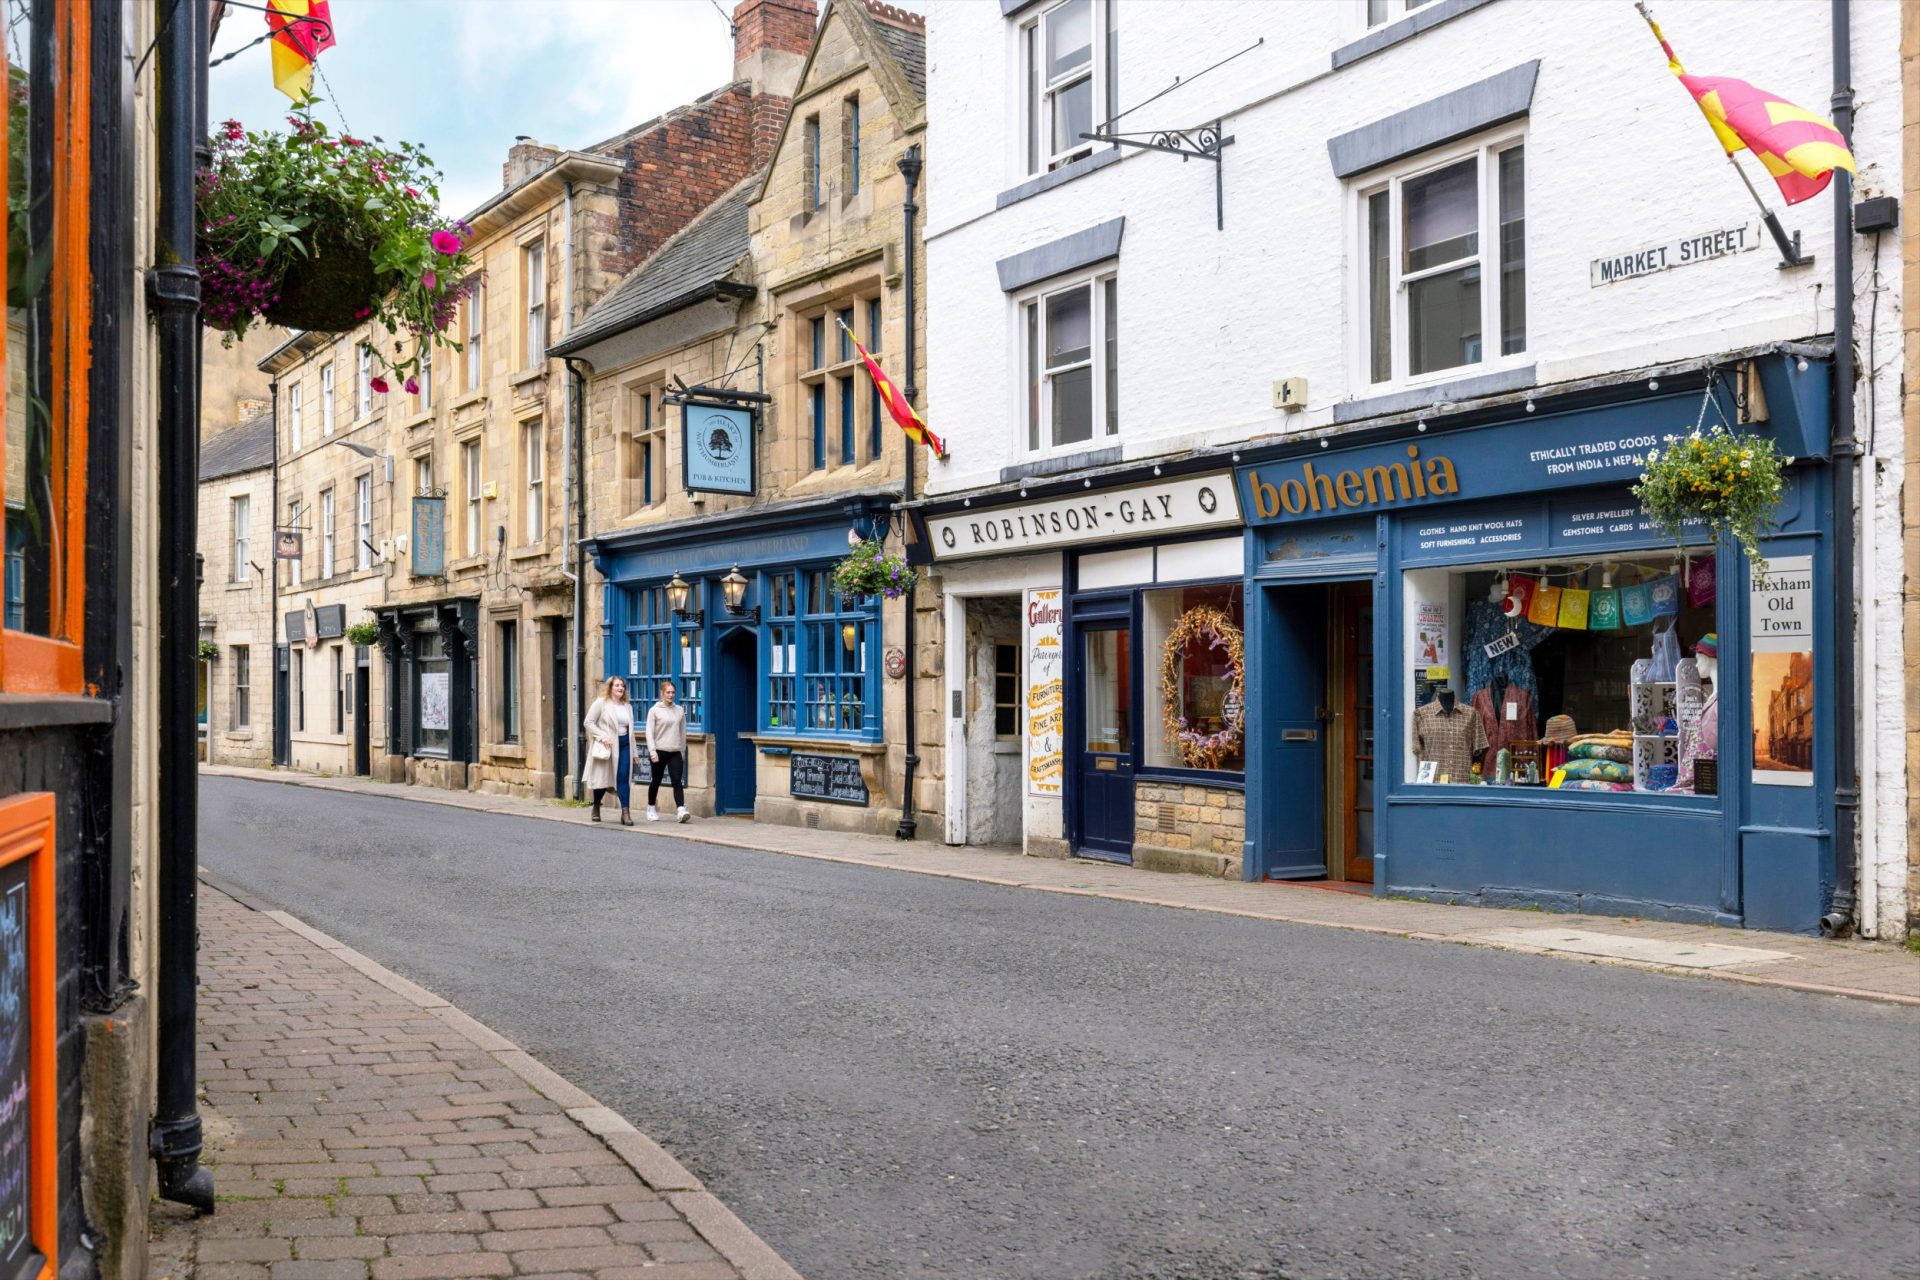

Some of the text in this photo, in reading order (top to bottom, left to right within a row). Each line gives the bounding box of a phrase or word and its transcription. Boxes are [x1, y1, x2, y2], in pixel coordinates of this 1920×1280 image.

[1601, 227, 1747, 281] MARKET STREET
[1530, 435, 1657, 461] ETHICALLY TRADED GOODS
[1547, 463, 1574, 475] FROM
[1576, 459, 1603, 471] INDIA
[1605, 458, 1611, 467] &
[693, 473, 706, 481] PUB
[714, 475, 746, 484] KITCHEN
[1249, 444, 1459, 518] bohemia
[970, 494, 1173, 543] ROBINSON-GAY
[1572, 511, 1598, 522] SILVER
[1596, 508, 1635, 520] JEWELLERY
[1420, 520, 1522, 536] CLOTHES HAND KNIT WOOL HATS
[1563, 526, 1604, 537] GEMSTONES
[1609, 523, 1633, 533] CARDS
[1420, 533, 1522, 549] SOFT FURNISHINGS ACCESSORIES
[1752, 577, 1811, 592] Hexham
[1768, 597, 1794, 611] Old
[1761, 618, 1802, 631] Town
[1489, 635, 1515, 655] NEW
[1033, 719, 1049, 730] FINE
[1045, 736, 1051, 752] &
